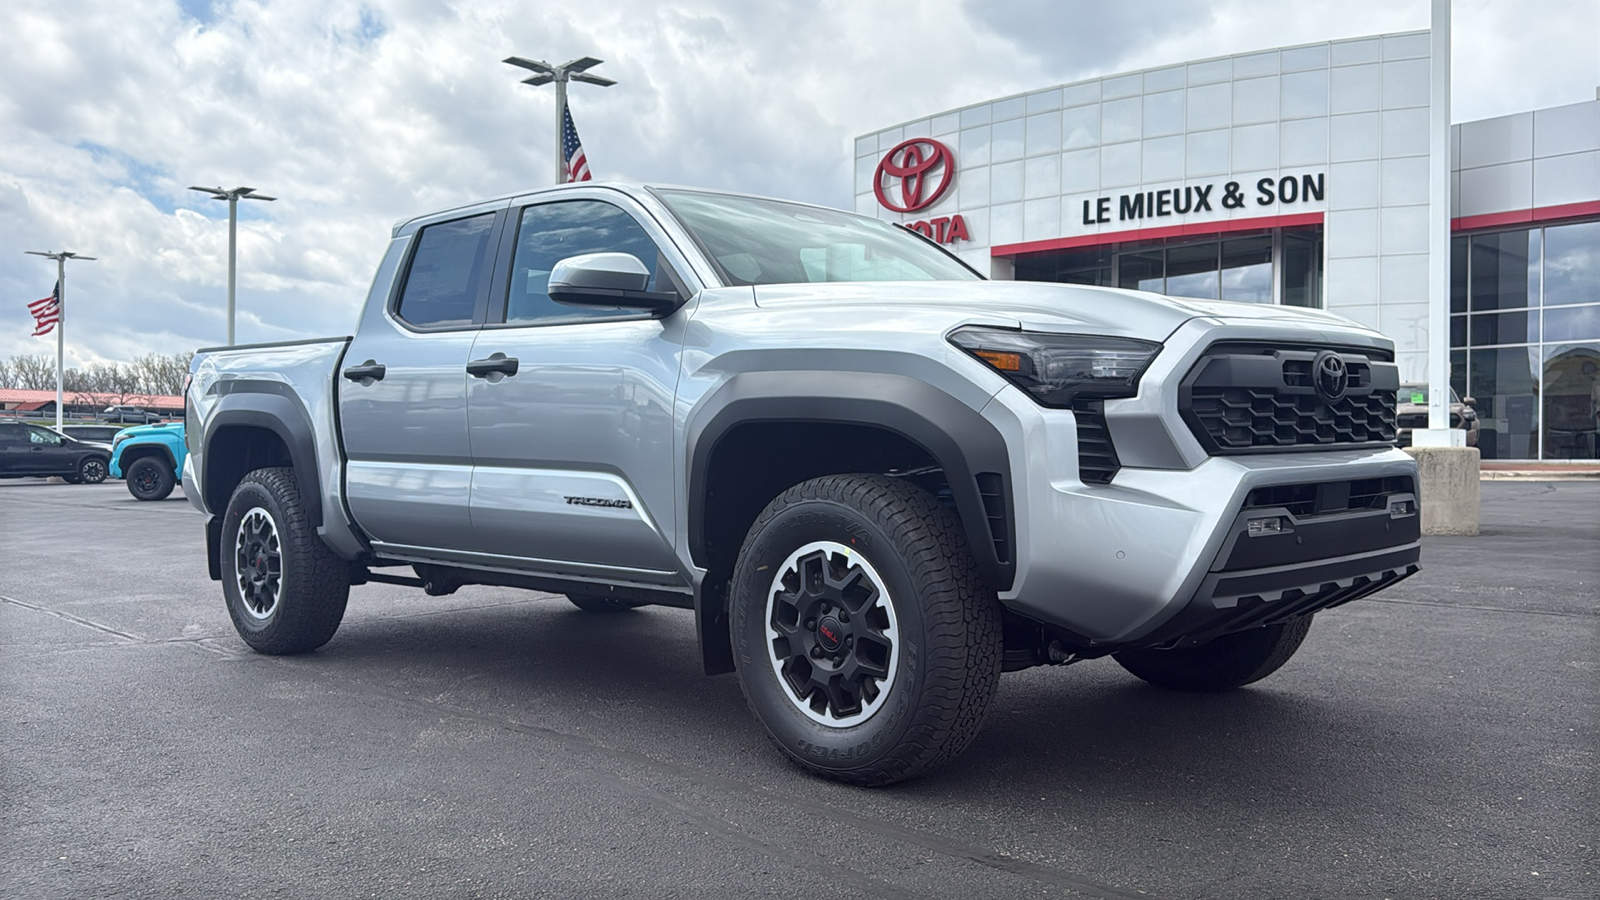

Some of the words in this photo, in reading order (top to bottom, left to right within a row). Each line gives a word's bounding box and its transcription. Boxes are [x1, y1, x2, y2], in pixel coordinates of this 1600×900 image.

[1083, 197, 1110, 225] LE
[1119, 184, 1213, 221] MIEUX
[1221, 181, 1245, 209] &
[1256, 173, 1324, 206] SON
[905, 214, 969, 245] OTA
[563, 495, 632, 509] TACOMA
